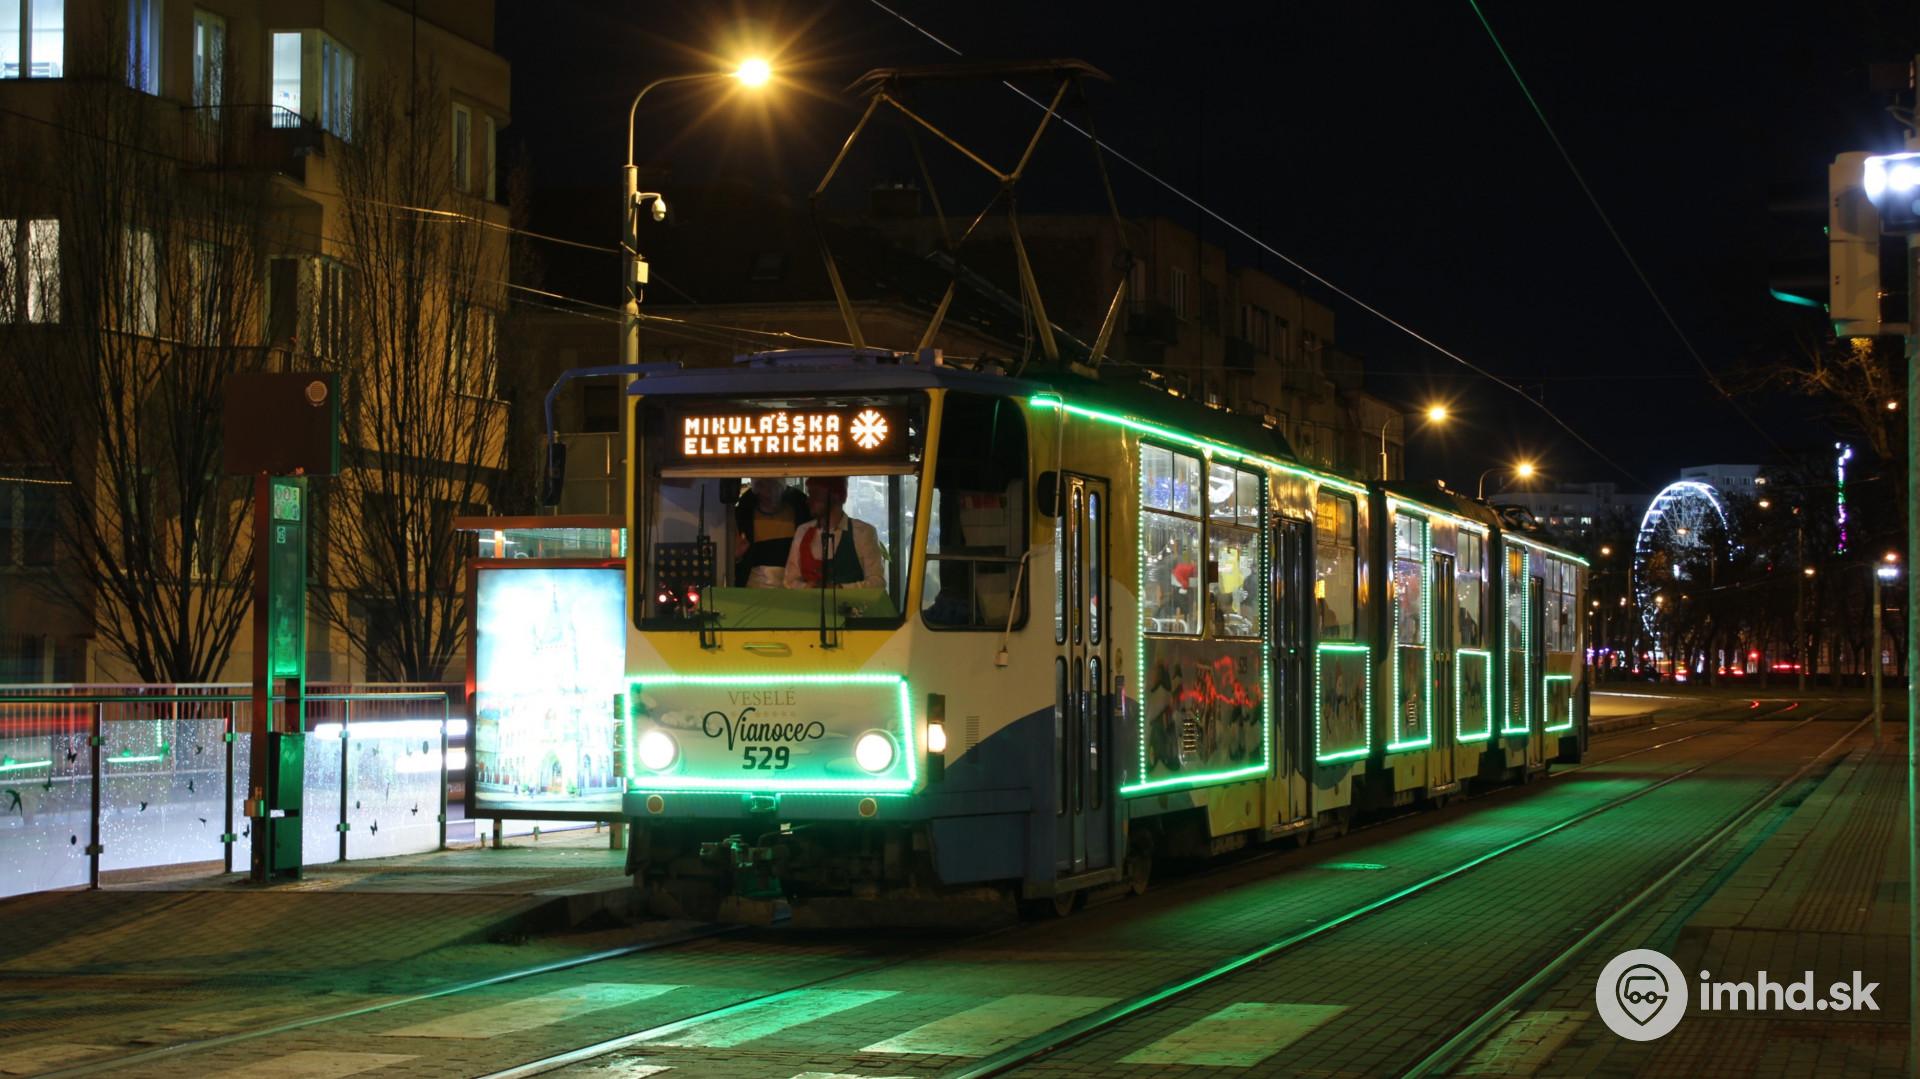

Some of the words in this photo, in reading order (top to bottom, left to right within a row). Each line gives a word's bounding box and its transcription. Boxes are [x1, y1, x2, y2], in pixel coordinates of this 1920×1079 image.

[684, 412, 840, 436] MIKULÁŠSKA
[684, 432, 840, 455] ELEKTRIČKA
[728, 687, 796, 706] VESELÉ
[703, 707, 825, 750] Vianoce
[742, 747, 790, 770] 529
